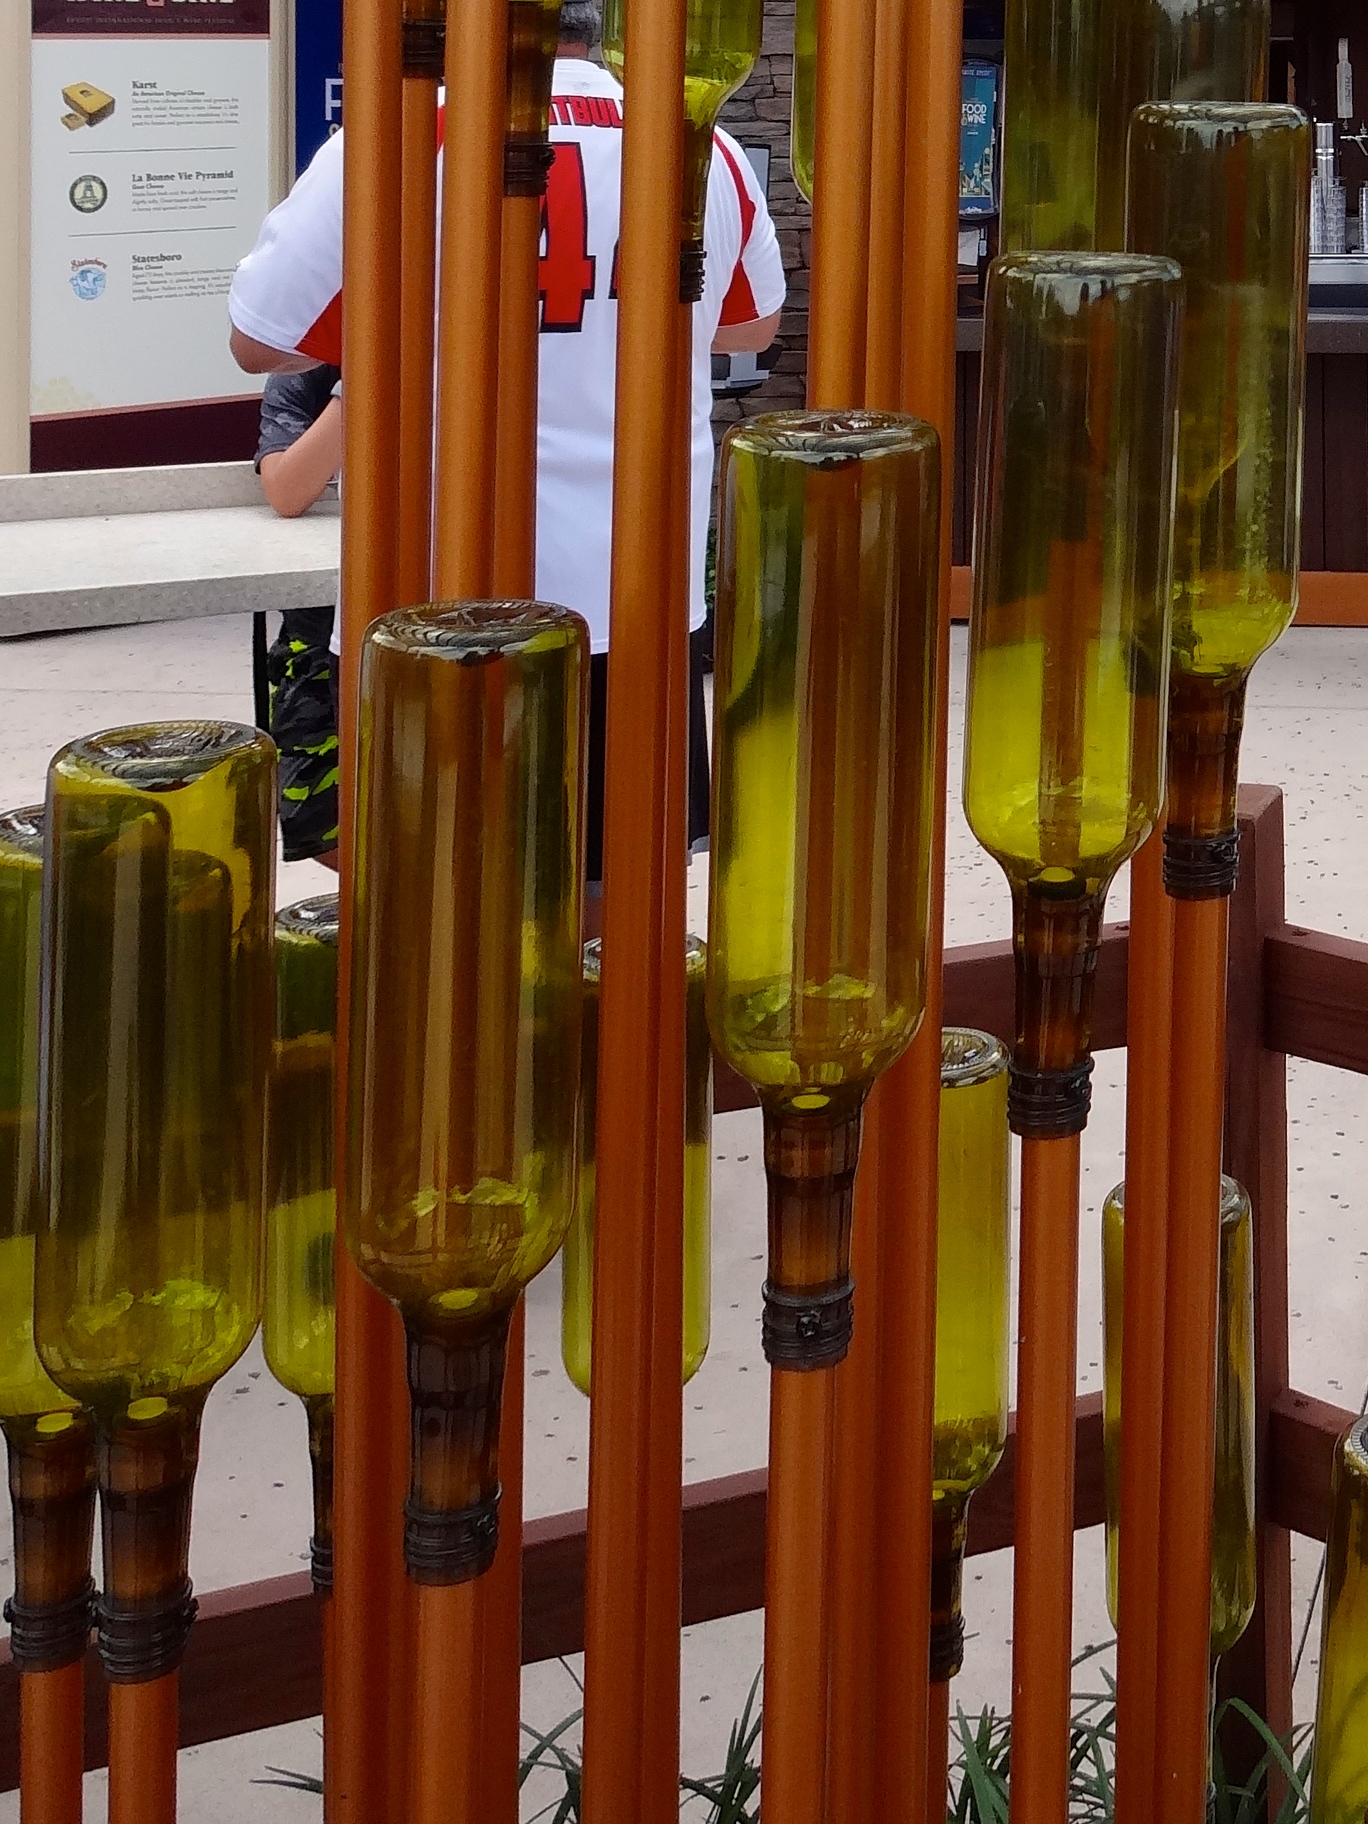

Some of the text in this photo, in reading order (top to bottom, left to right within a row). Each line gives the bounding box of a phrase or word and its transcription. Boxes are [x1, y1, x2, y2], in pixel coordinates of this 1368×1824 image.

[131, 80, 158, 89] Karst
[961, 103, 987, 114] FOOD
[967, 113, 987, 124] WINE
[131, 170, 234, 182] La Bonne Vie Pyramid
